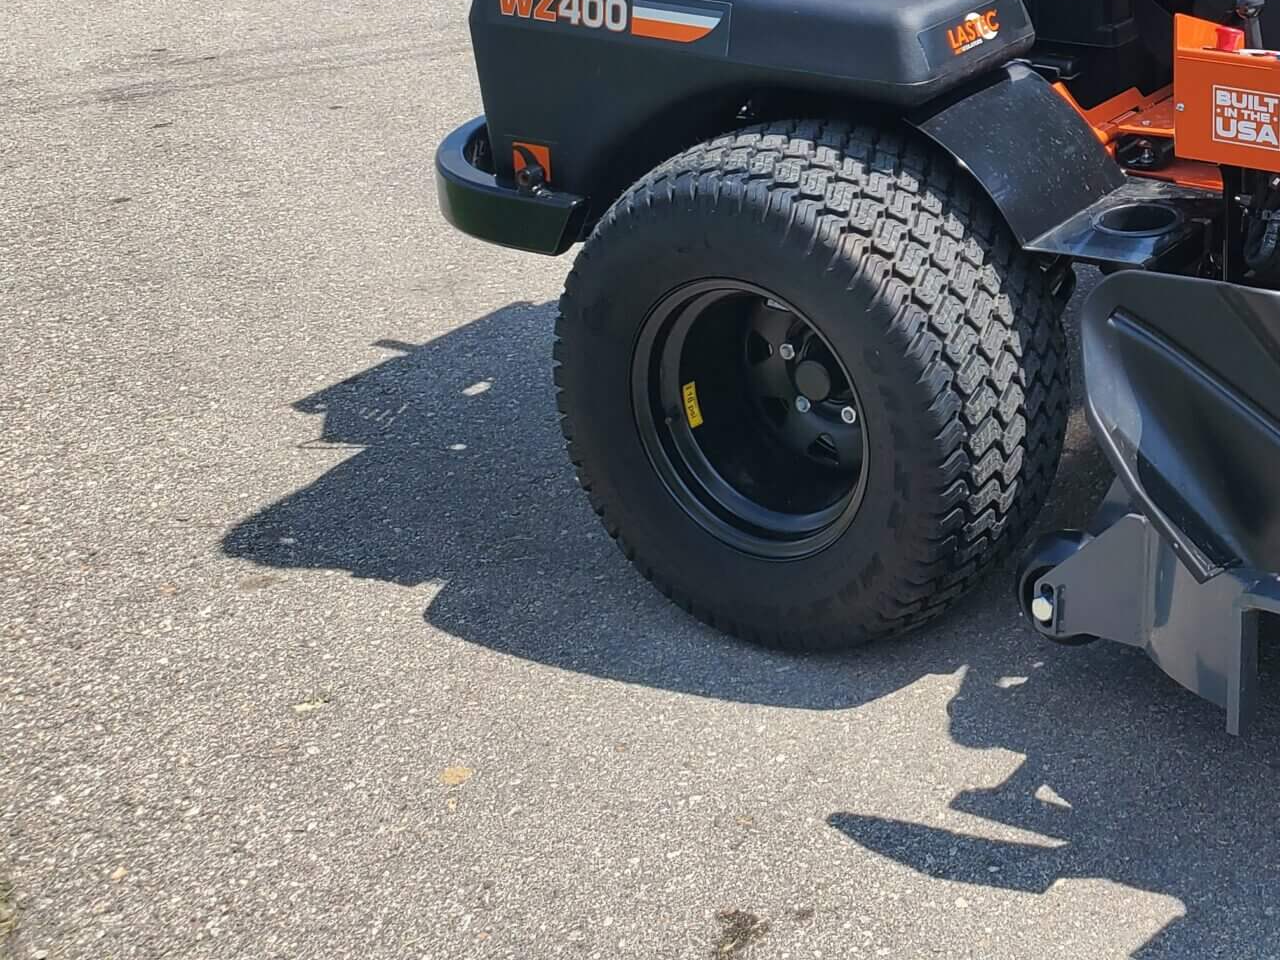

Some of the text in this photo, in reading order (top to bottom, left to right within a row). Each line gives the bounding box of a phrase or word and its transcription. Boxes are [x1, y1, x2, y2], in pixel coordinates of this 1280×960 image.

[946, 8, 1000, 49] LASTEC
[1215, 90, 1279, 112] BUILT
[1224, 109, 1270, 122] IN THE
[1216, 118, 1279, 146] USA
